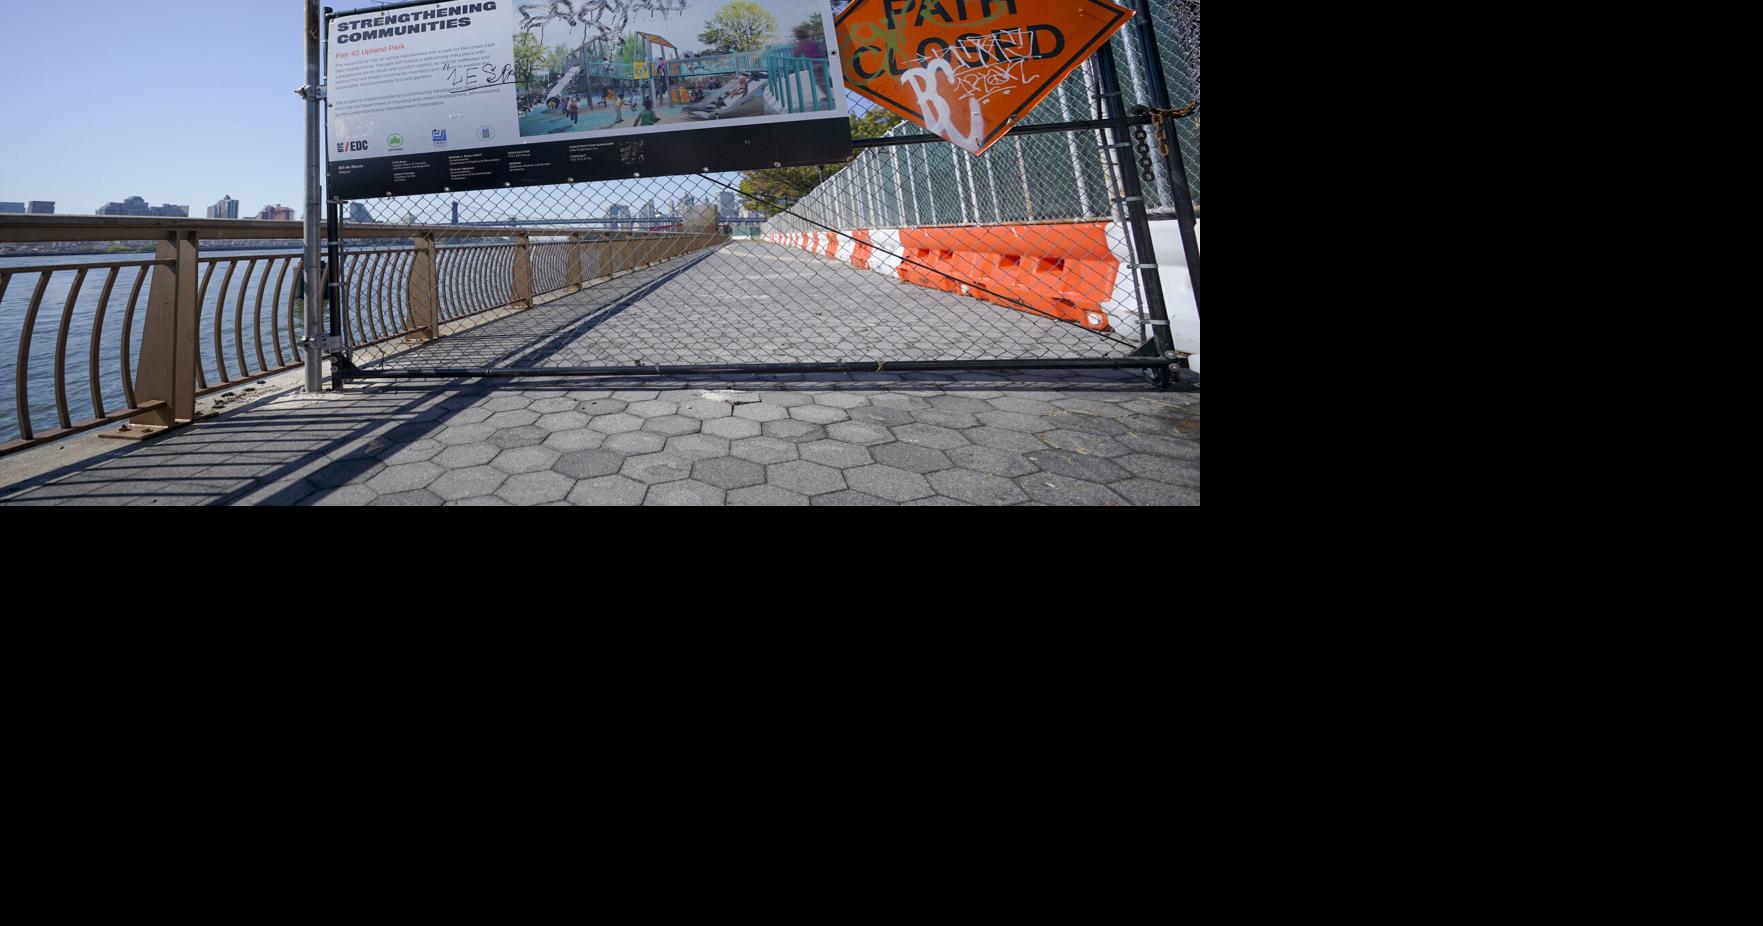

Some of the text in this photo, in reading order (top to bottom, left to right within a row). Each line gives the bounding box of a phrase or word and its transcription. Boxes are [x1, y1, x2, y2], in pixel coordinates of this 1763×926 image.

[337, 1, 497, 32] STRENGTHENING
[337, 17, 472, 44] COMMUNITIES
[335, 51, 349, 59] Pier
[361, 46, 387, 56] Upland
[388, 43, 406, 53] Park
[852, 23, 1065, 80] CLOSED
